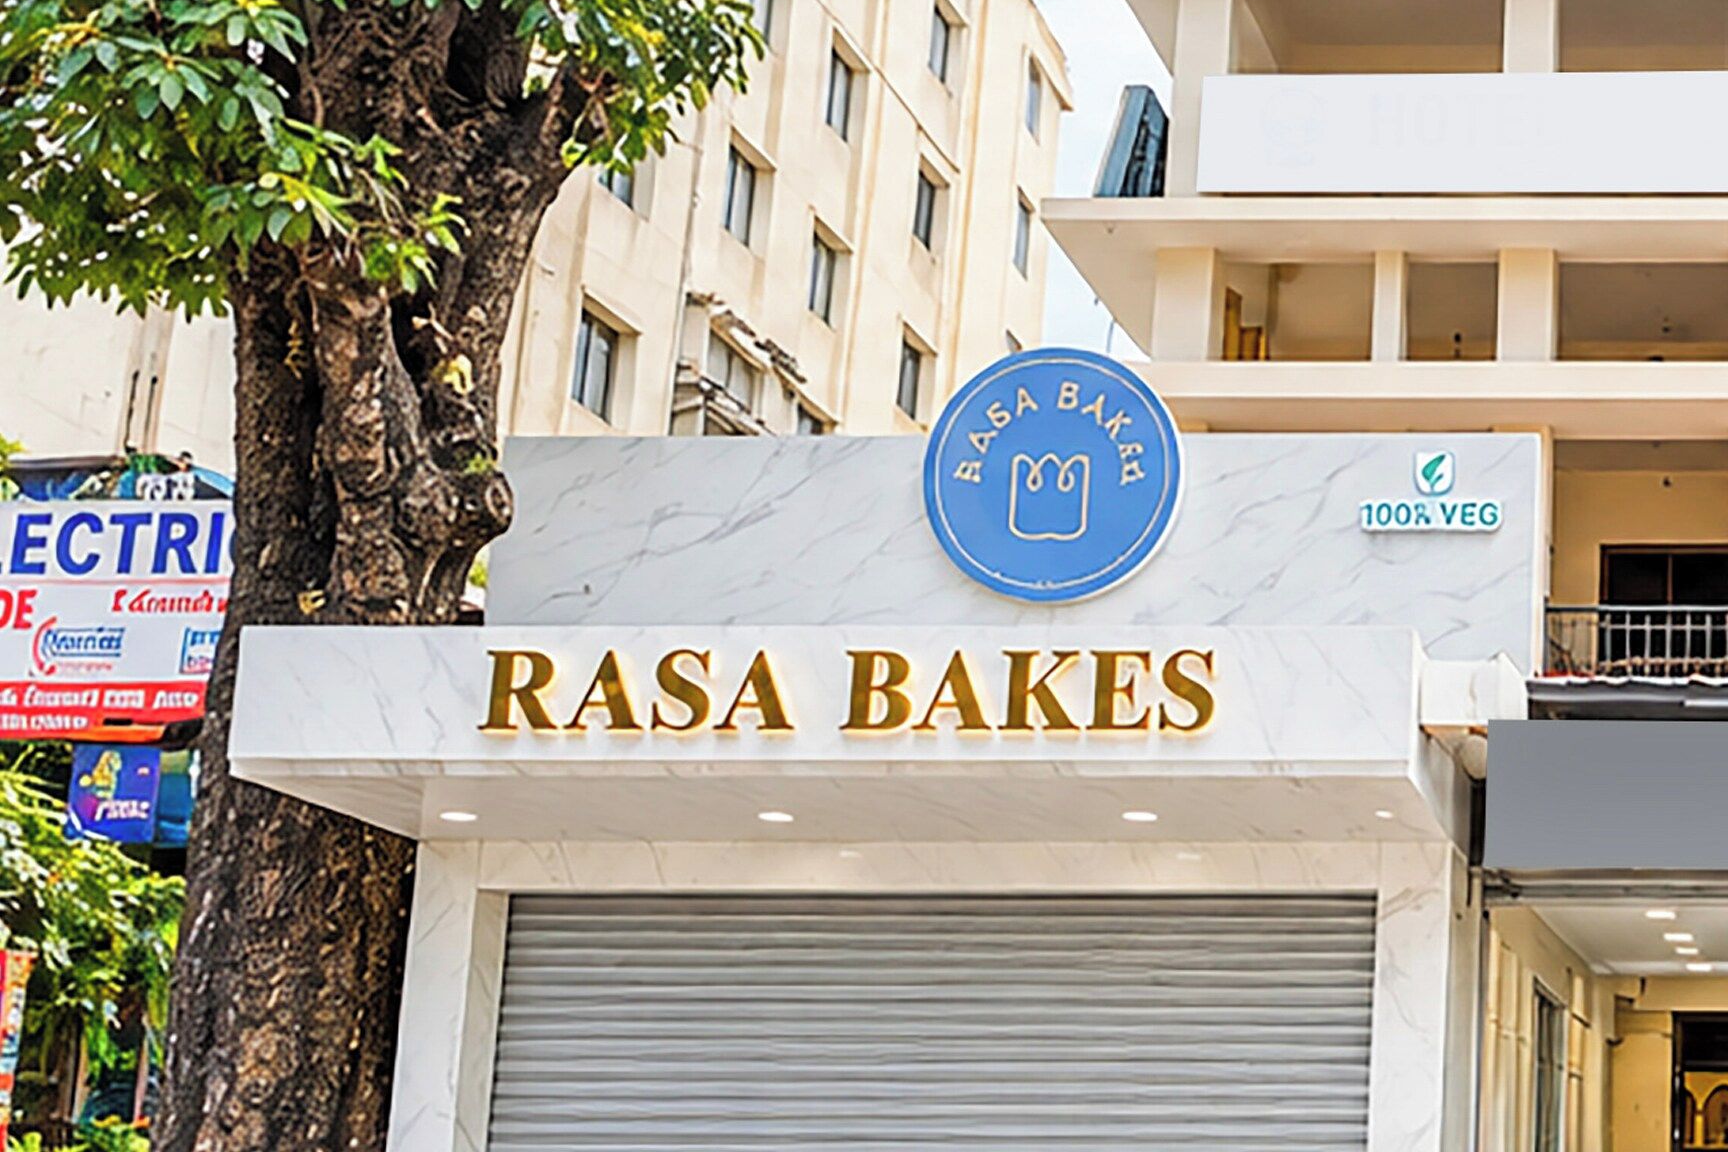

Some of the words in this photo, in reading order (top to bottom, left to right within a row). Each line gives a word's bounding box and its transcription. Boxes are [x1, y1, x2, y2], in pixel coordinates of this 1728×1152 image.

[0, 512, 234, 575] ECTRI
[1439, 501, 1499, 526] VEG
[478, 648, 795, 731] RASA
[840, 648, 1216, 732] BAKES
